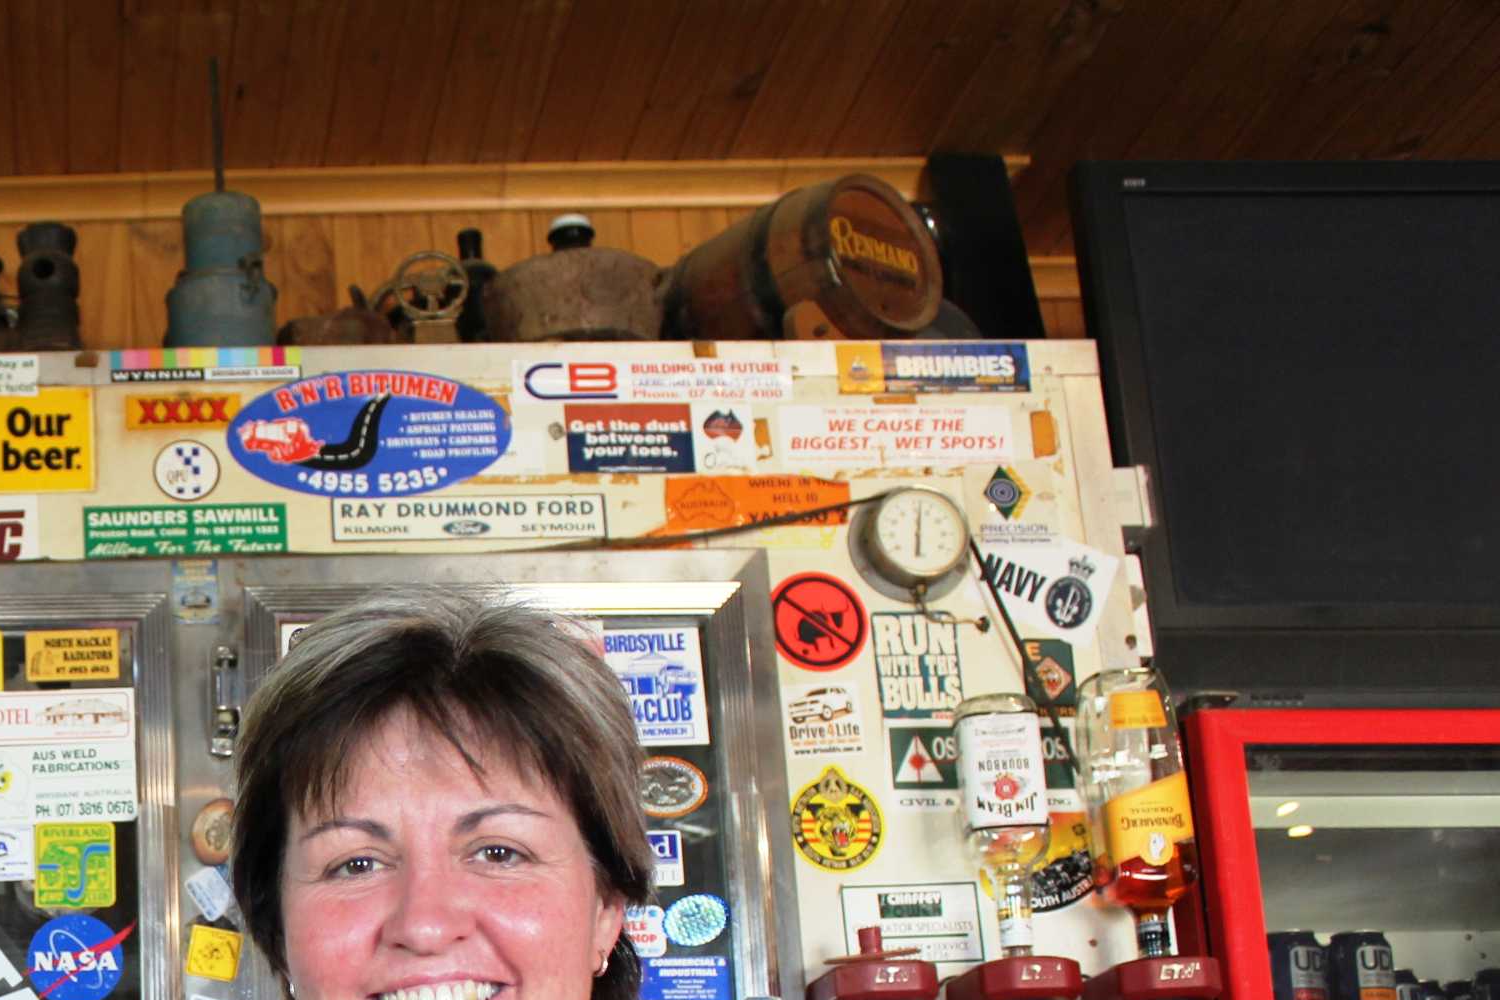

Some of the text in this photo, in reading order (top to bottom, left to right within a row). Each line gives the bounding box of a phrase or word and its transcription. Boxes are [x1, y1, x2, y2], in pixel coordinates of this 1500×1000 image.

[631, 362, 782, 375] BUILDING THE FUTURE
[894, 354, 1017, 378] BRUMBIES
[112, 368, 204, 382] WYNNUM
[348, 372, 459, 405] BITUMEN
[138, 398, 230, 425] XXXX
[6, 406, 72, 438] Our
[569, 417, 688, 434] Get the dust
[828, 418, 966, 433] WE CAUSE THE
[584, 431, 669, 446] between
[894, 436, 936, 450] WET
[939, 435, 1005, 450] SPOTS!
[1, 440, 82, 472] beer.
[581, 443, 680, 459] your toes.
[87, 507, 280, 527] SAUNDERS SAWMILL
[340, 500, 595, 518] RAY DRUMMOND FORD
[343, 524, 411, 535] KILMORE
[520, 521, 597, 533] SEYMOUR
[979, 522, 1049, 535] PRECISION
[984, 553, 1047, 604] NAVY
[603, 632, 686, 654] BIRDSVILLE
[876, 614, 958, 656] RUN
[878, 653, 959, 678] WITH THE
[882, 674, 964, 711] BULLS
[32, 748, 99, 762] AUS WELD
[31, 760, 122, 774] FABRICATIONS
[978, 757, 1030, 772] BOURBON
[976, 792, 1038, 818] JIM BEAM
[1120, 813, 1185, 830] BUNDABERG
[33, 952, 119, 973] NASA
